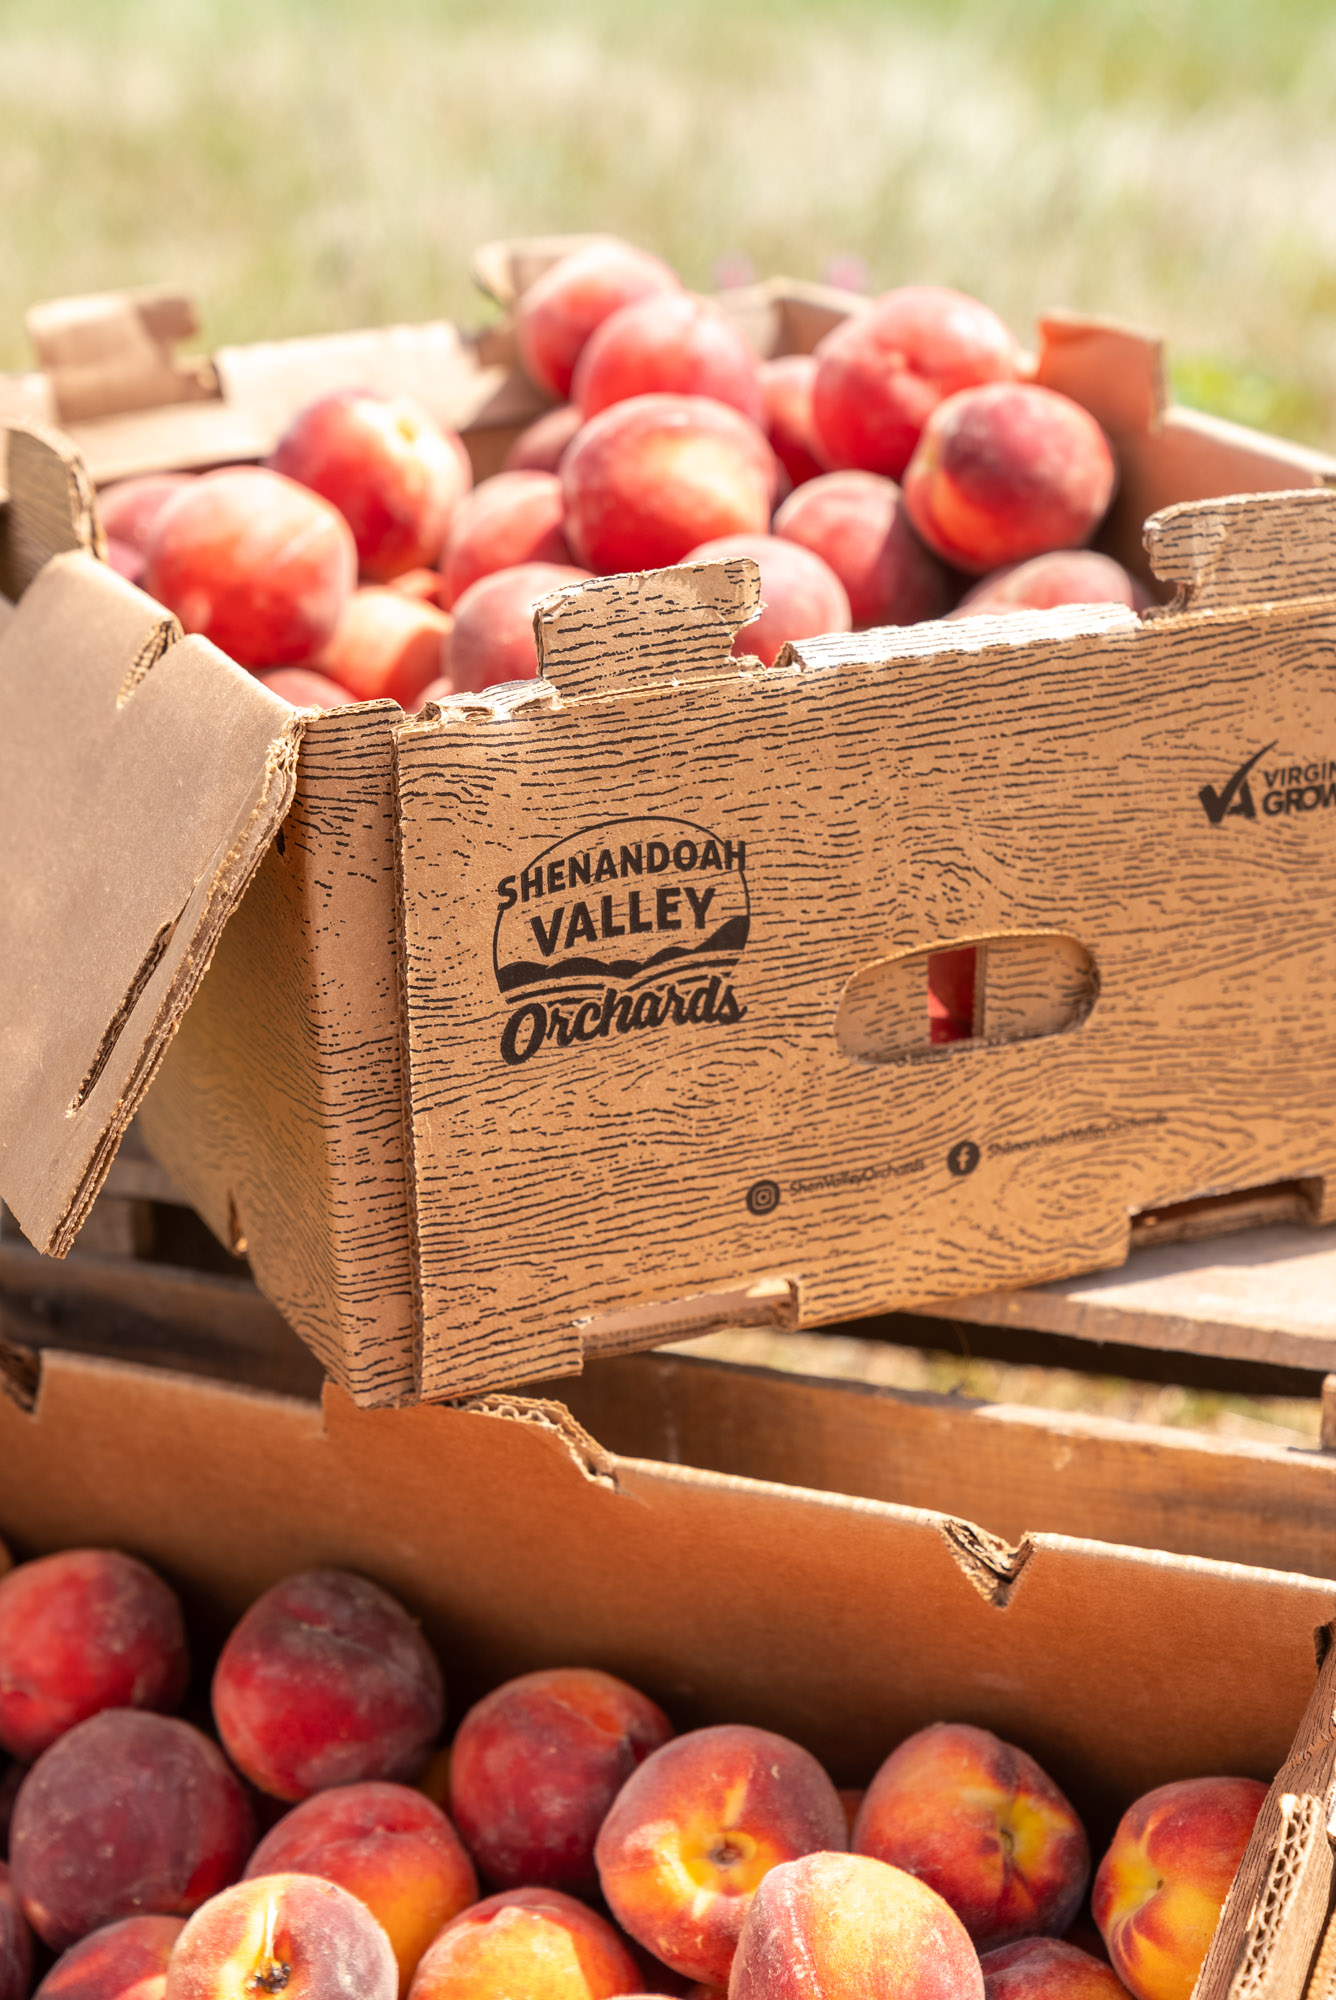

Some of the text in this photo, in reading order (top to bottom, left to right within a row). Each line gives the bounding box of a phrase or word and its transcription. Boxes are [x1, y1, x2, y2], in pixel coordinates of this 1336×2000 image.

[497, 839, 746, 911] SHENANDOAH
[530, 887, 716, 957] VALLEY
[500, 975, 748, 1065] Orchards
